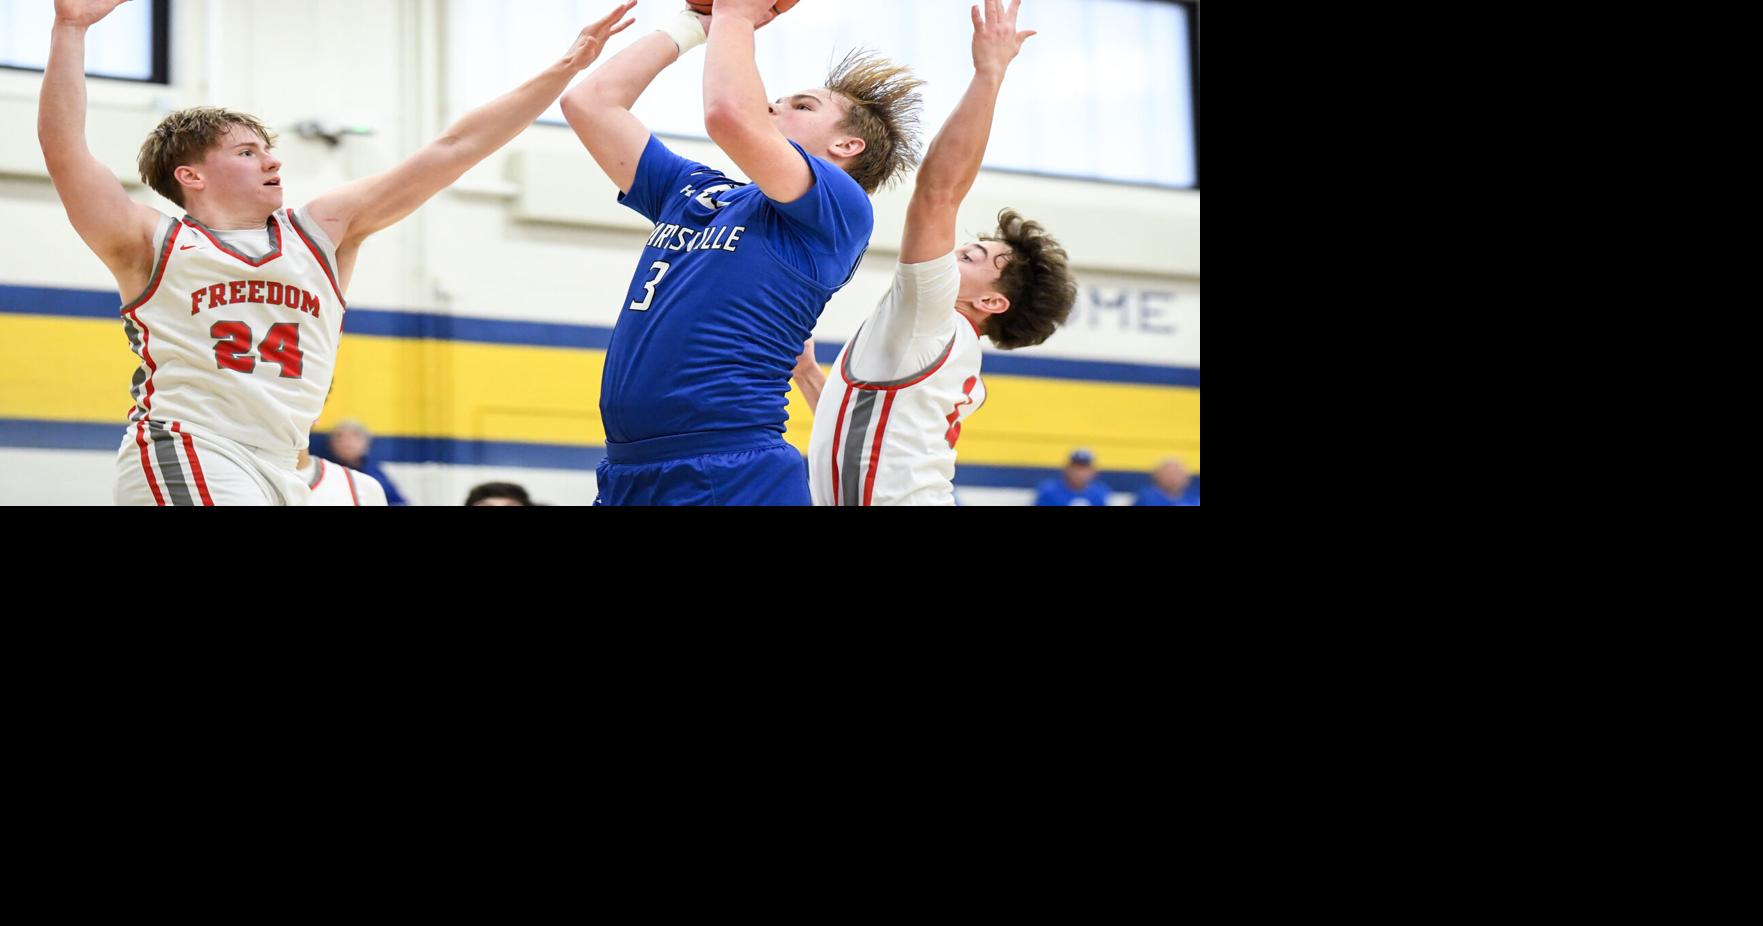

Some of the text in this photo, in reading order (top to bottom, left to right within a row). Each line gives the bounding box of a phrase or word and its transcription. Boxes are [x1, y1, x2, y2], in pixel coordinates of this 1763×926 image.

[190, 280, 321, 318] FREEDOM
[629, 260, 670, 311] 3
[1069, 287, 1177, 335] ME
[210, 320, 304, 379] 24
